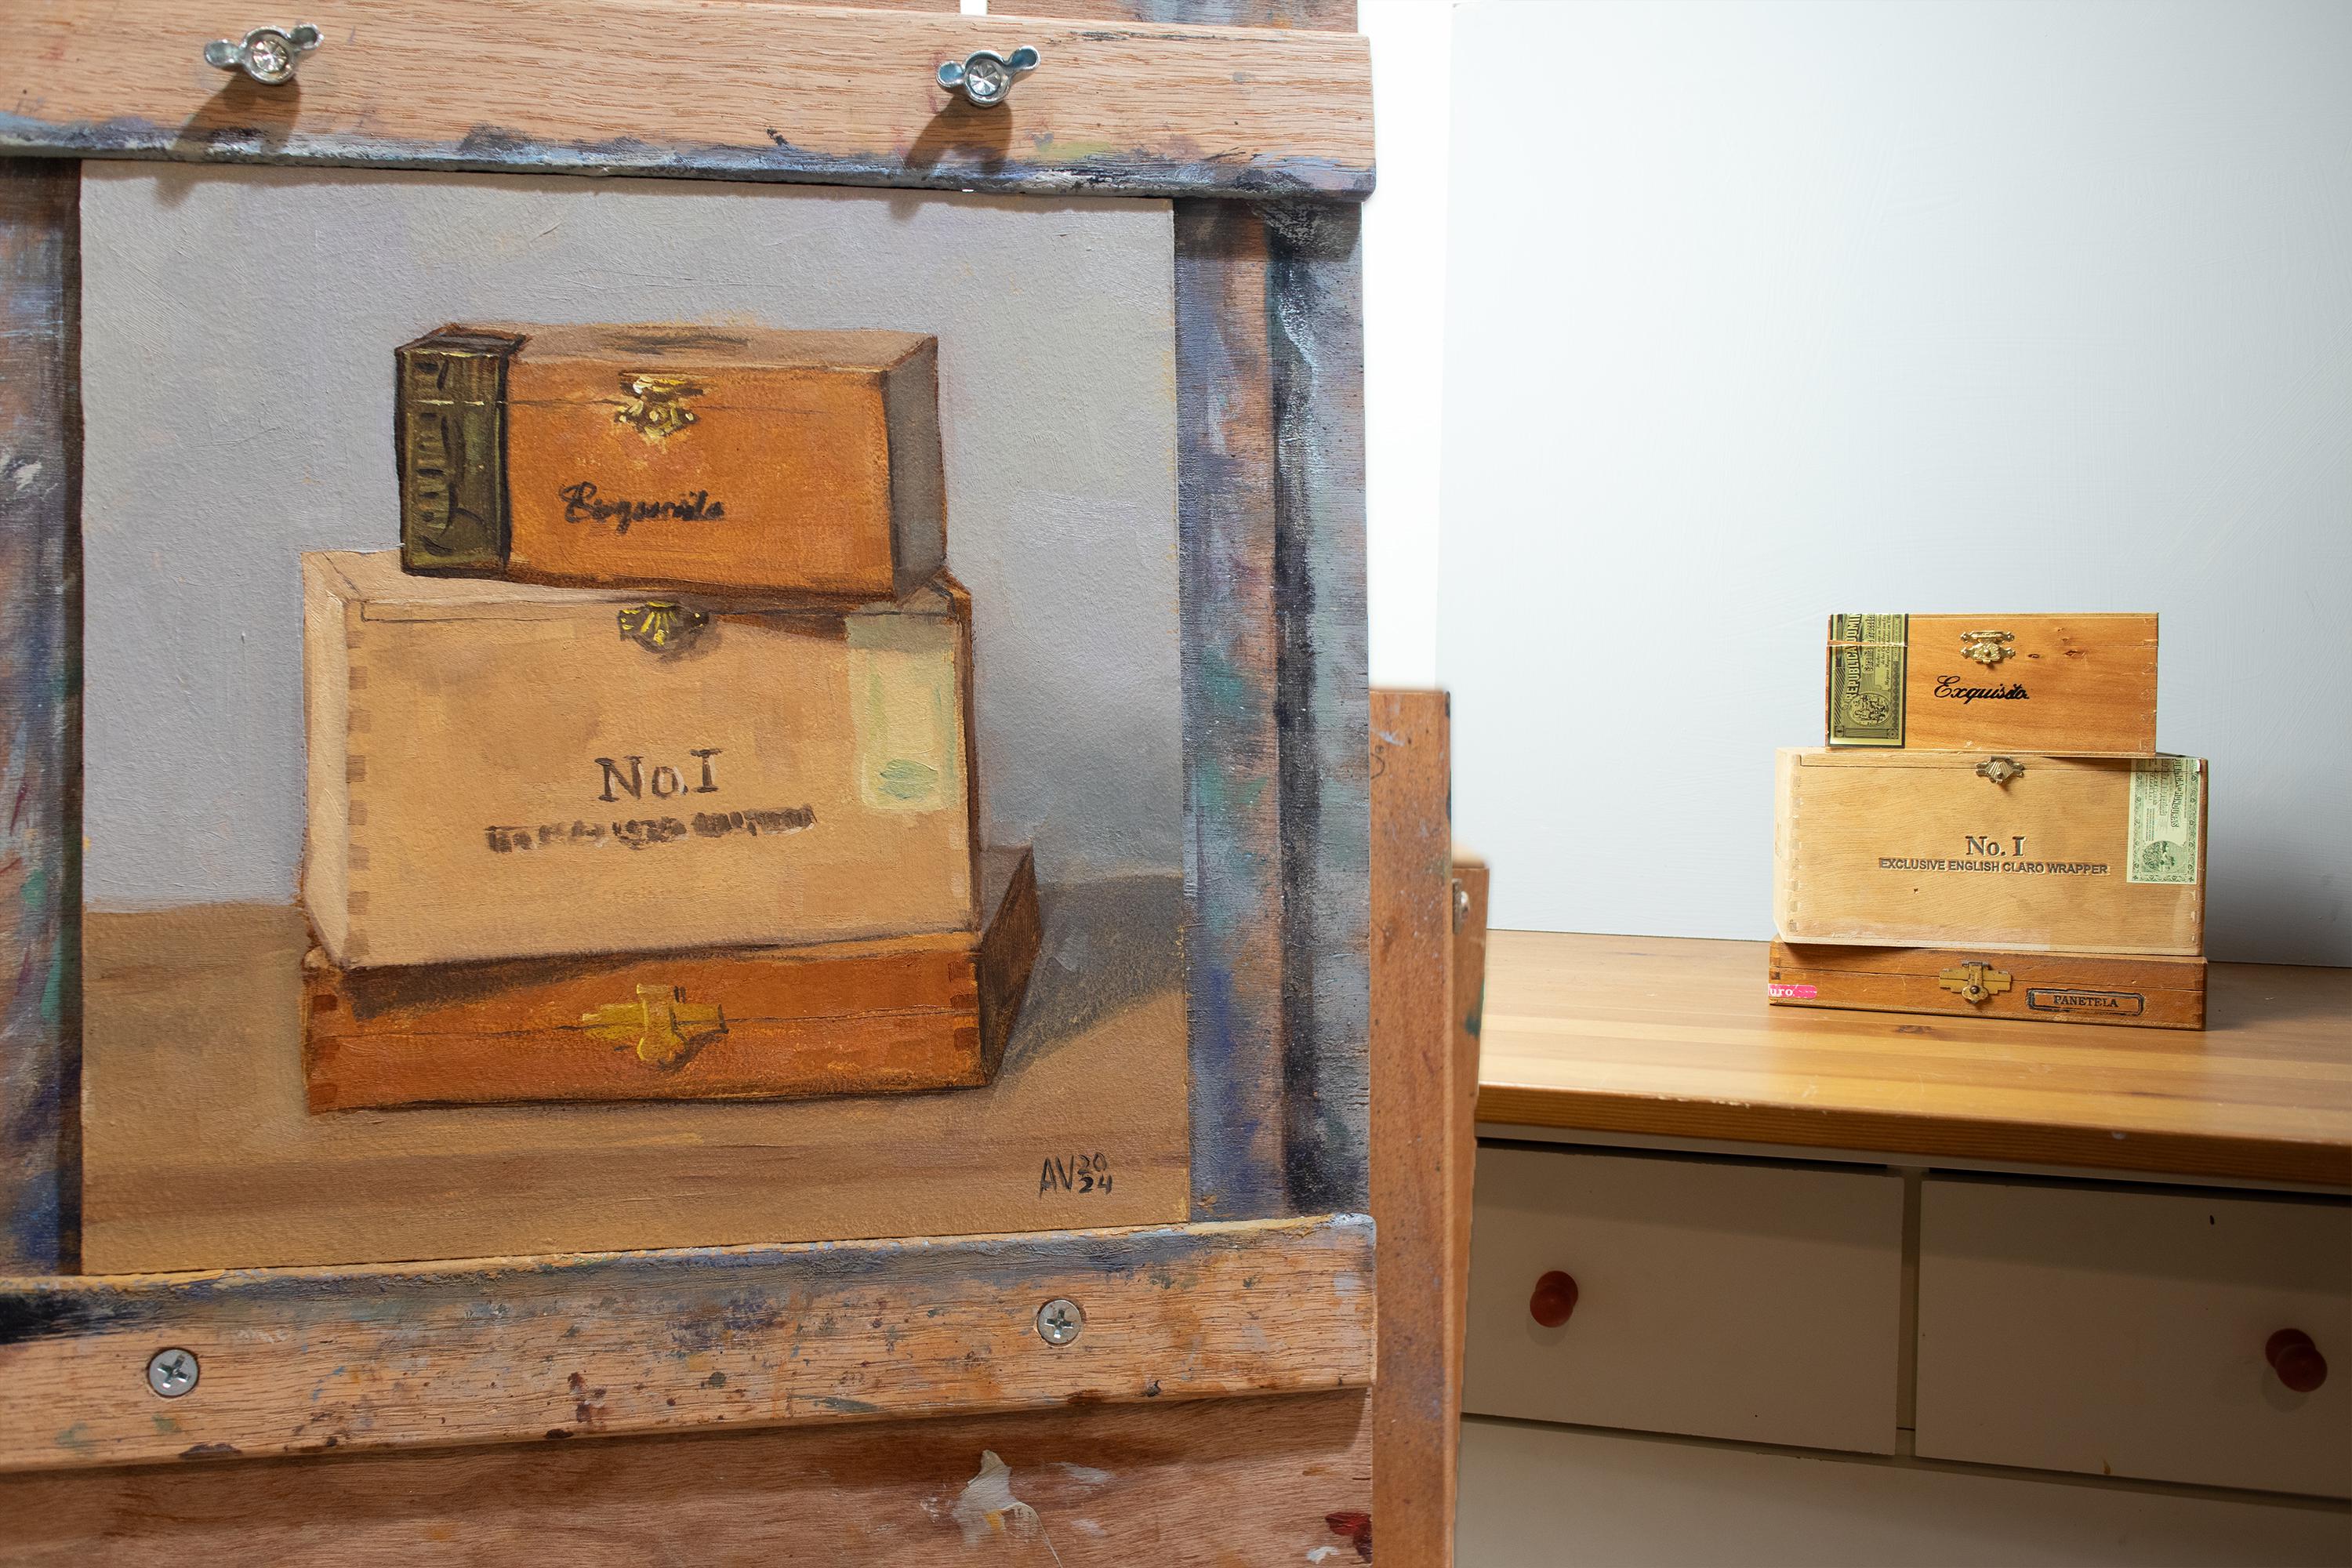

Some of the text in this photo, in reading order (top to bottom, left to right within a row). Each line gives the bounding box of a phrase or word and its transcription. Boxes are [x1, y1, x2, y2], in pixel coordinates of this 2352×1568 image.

[1845, 645, 1861, 699] REPUBLICA
[2171, 791, 2183, 828] HONDURAS
[1965, 835, 2006, 856] No.
[1879, 858, 2109, 875] EXCLUSIVE ENGLISH CLARO WRAPPER
[2053, 995, 2119, 1007] PANETELA
[1039, 1154, 1074, 1200] AV
